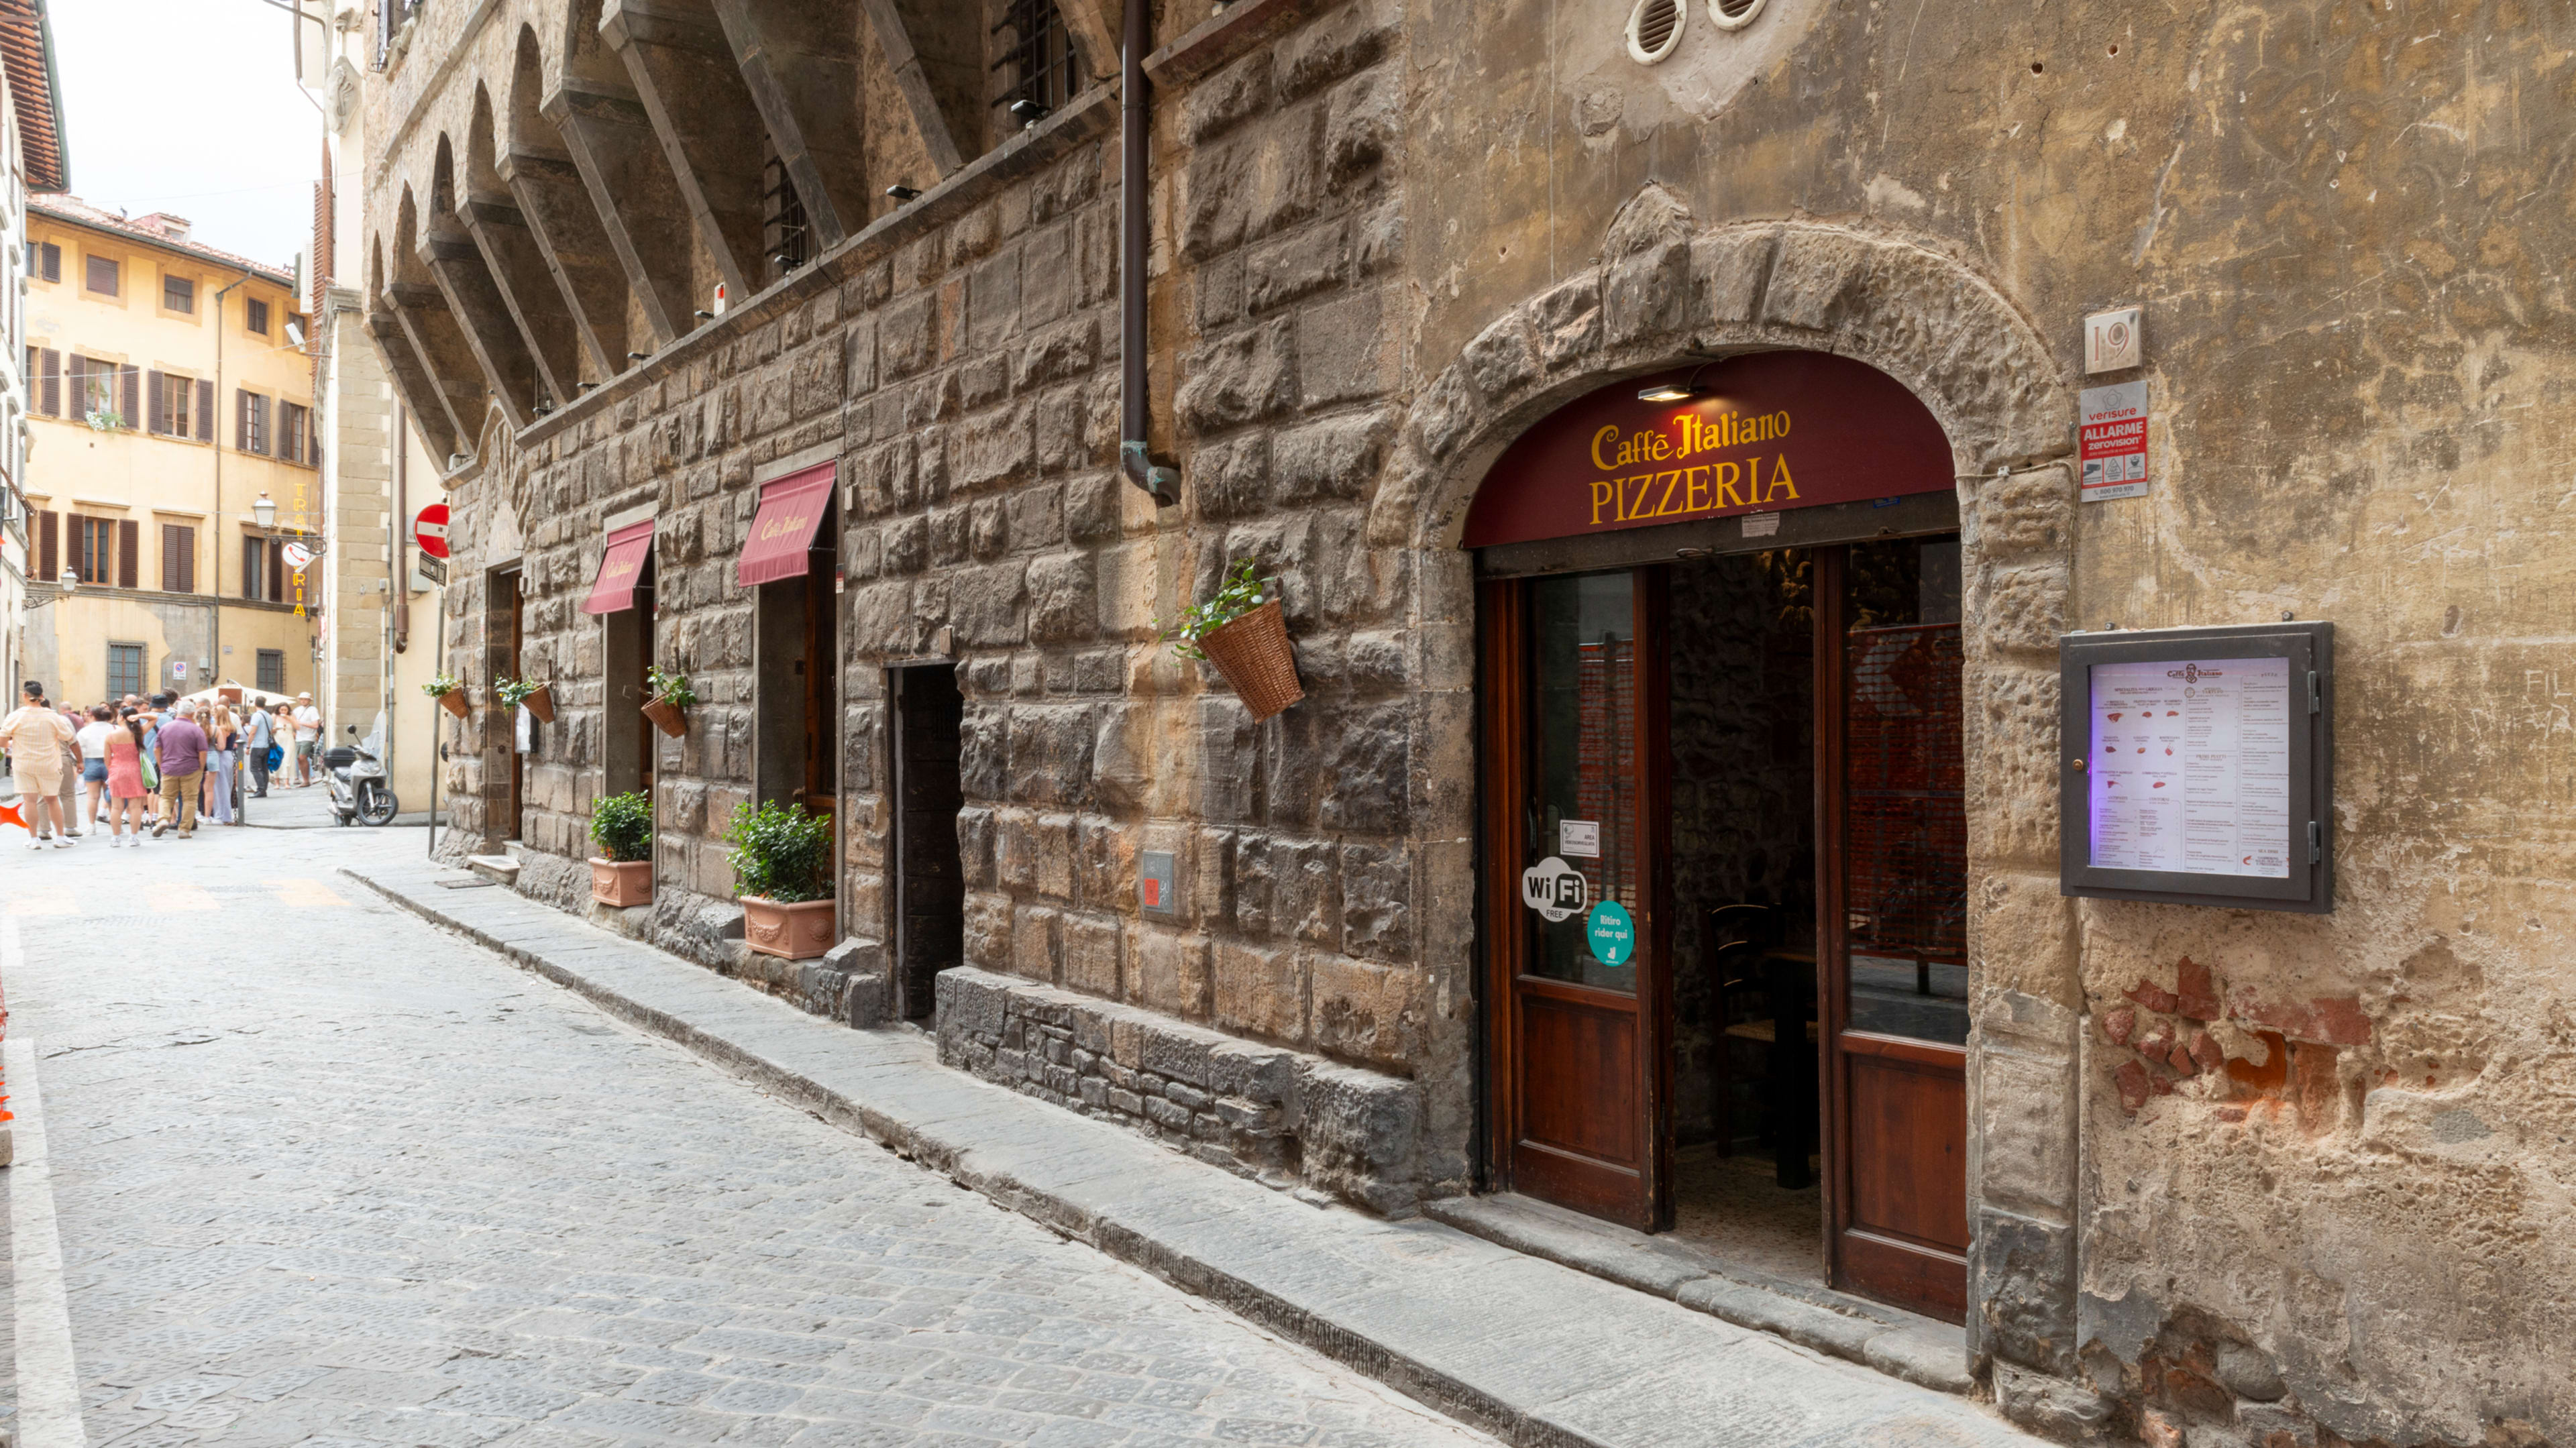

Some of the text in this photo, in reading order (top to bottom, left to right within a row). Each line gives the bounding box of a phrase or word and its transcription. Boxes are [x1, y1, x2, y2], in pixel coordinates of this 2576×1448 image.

[2093, 321, 2130, 362] 19
[2088, 407, 2137, 421] verisure
[1672, 409, 1792, 460] Italiano
[2083, 421, 2144, 441] ALLARME
[1589, 453, 1801, 525] PIZZERIA
[293, 483, 307, 617] TRATRIA
[1546, 909, 1564, 919] FREE
[1600, 914, 1621, 926] Ritiro
[1595, 927, 1627, 942] rider qui
